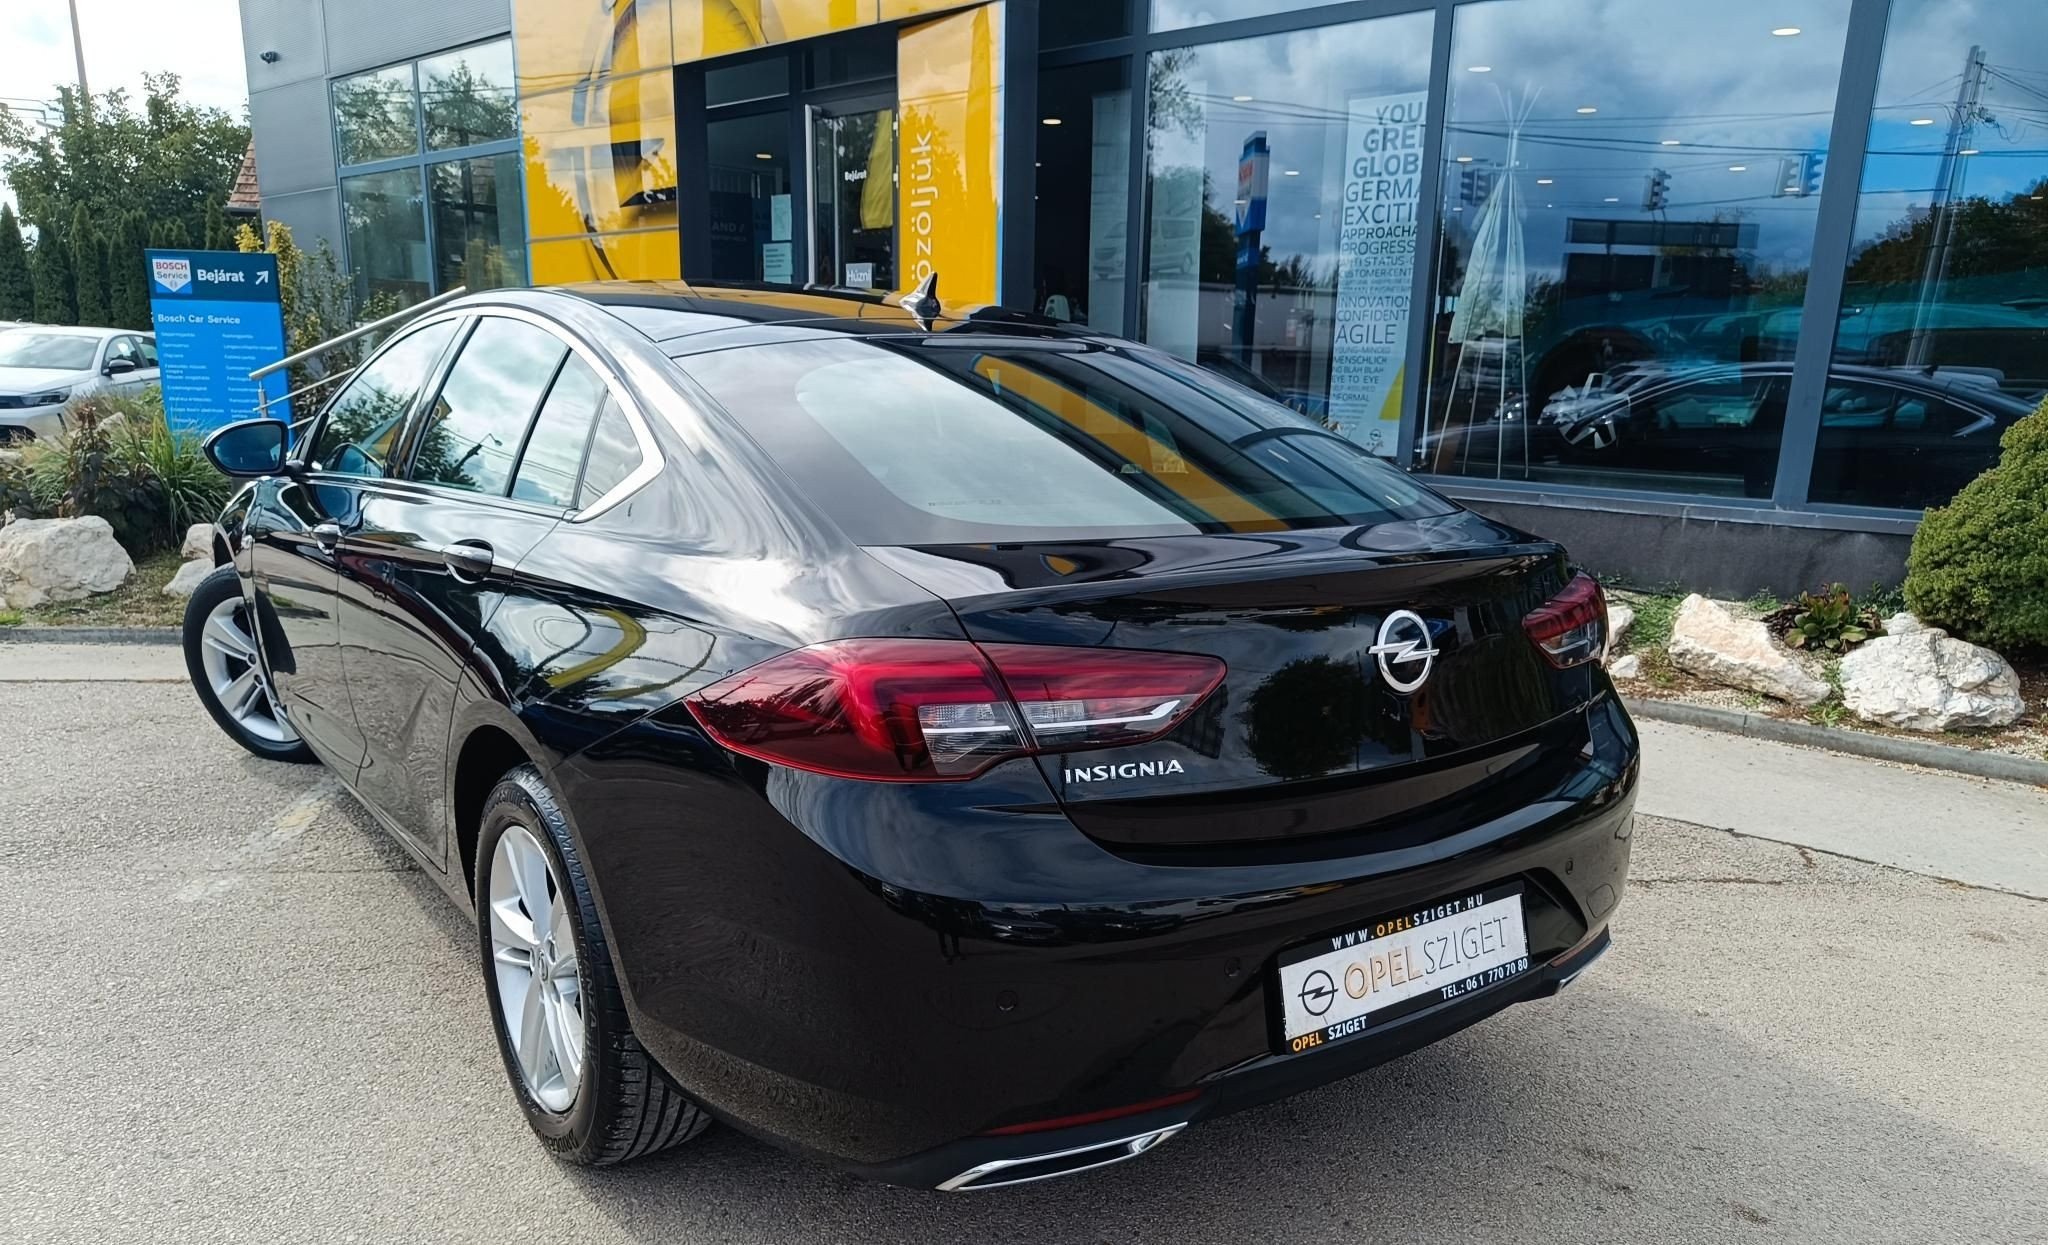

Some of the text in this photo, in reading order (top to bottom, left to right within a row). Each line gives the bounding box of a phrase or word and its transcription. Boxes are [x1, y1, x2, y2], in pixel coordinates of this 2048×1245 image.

[1376, 102, 1423, 125] YOU
[1353, 153, 1419, 179] GLOB
[1344, 202, 1412, 226] EXCITI
[155, 261, 187, 271] BOSCH
[156, 270, 188, 280] Service
[197, 268, 245, 284] Bejárat
[158, 314, 240, 325] Bosch Car Service
[1336, 309, 1408, 322] CONFIDENT
[1335, 324, 1397, 345] AGILE
[1064, 759, 1184, 784] INSIGNIA
[1332, 893, 1483, 950] WWW.OPELSZIGET.HU
[1344, 916, 1509, 1000] OPELSZIGET
[1441, 983, 1465, 1000] TEL.:
[1487, 966, 1504, 983] 770
[1505, 961, 1516, 976] 70
[1517, 957, 1528, 971] 80
[1292, 1015, 1367, 1052] OPEL SZIGET
